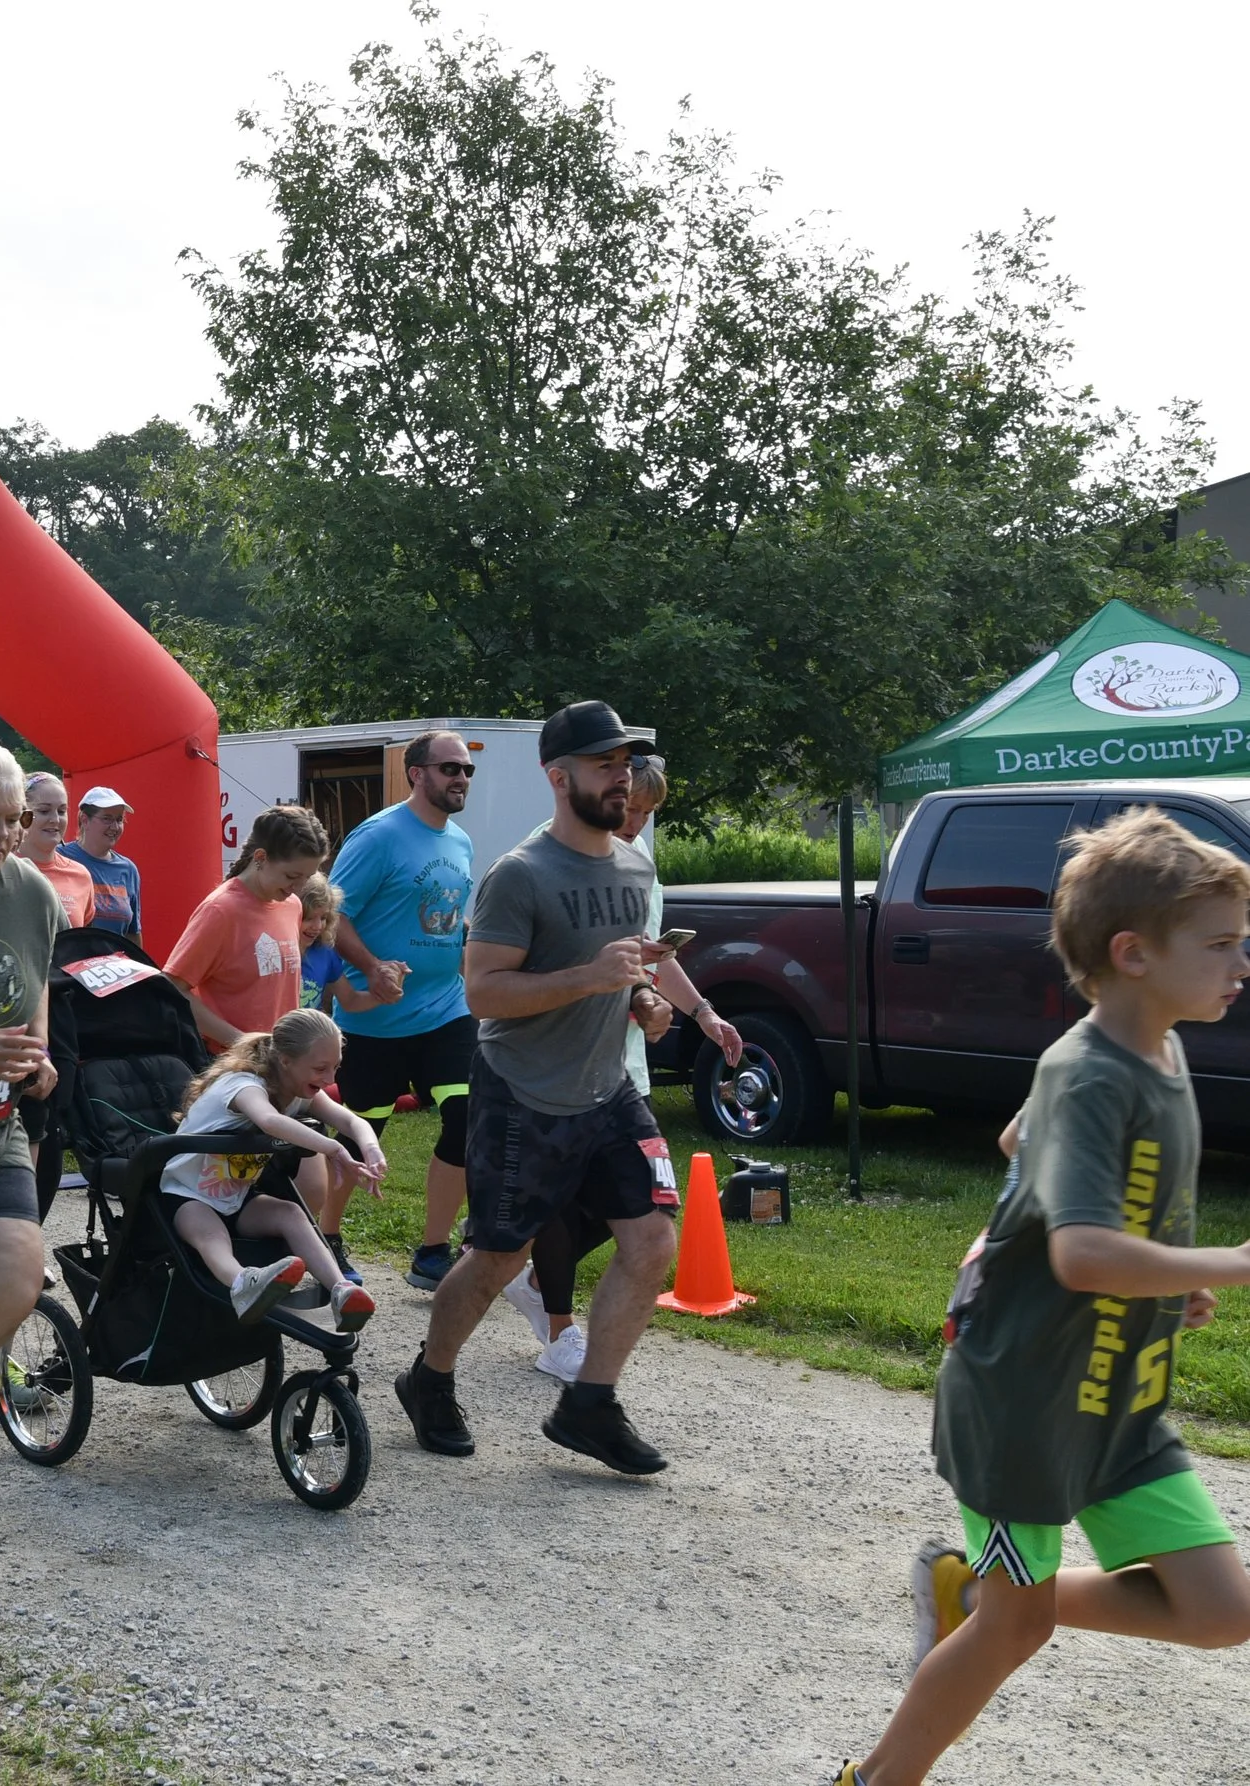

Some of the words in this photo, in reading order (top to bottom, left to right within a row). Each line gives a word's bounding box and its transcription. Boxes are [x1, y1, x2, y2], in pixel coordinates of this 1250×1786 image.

[1144, 681, 1211, 694] Parks
[1151, 664, 1205, 678] Darke
[996, 728, 1250, 773] DarkeCountyP
[882, 757, 950, 788] DarkeCountyParks.org
[413, 859, 441, 886] Raptor
[442, 856, 461, 874] Run
[503, 1109, 521, 1187] PRIMITIVE
[496, 1192, 514, 1229] BORN
[1077, 1294, 1128, 1417] Rapt
